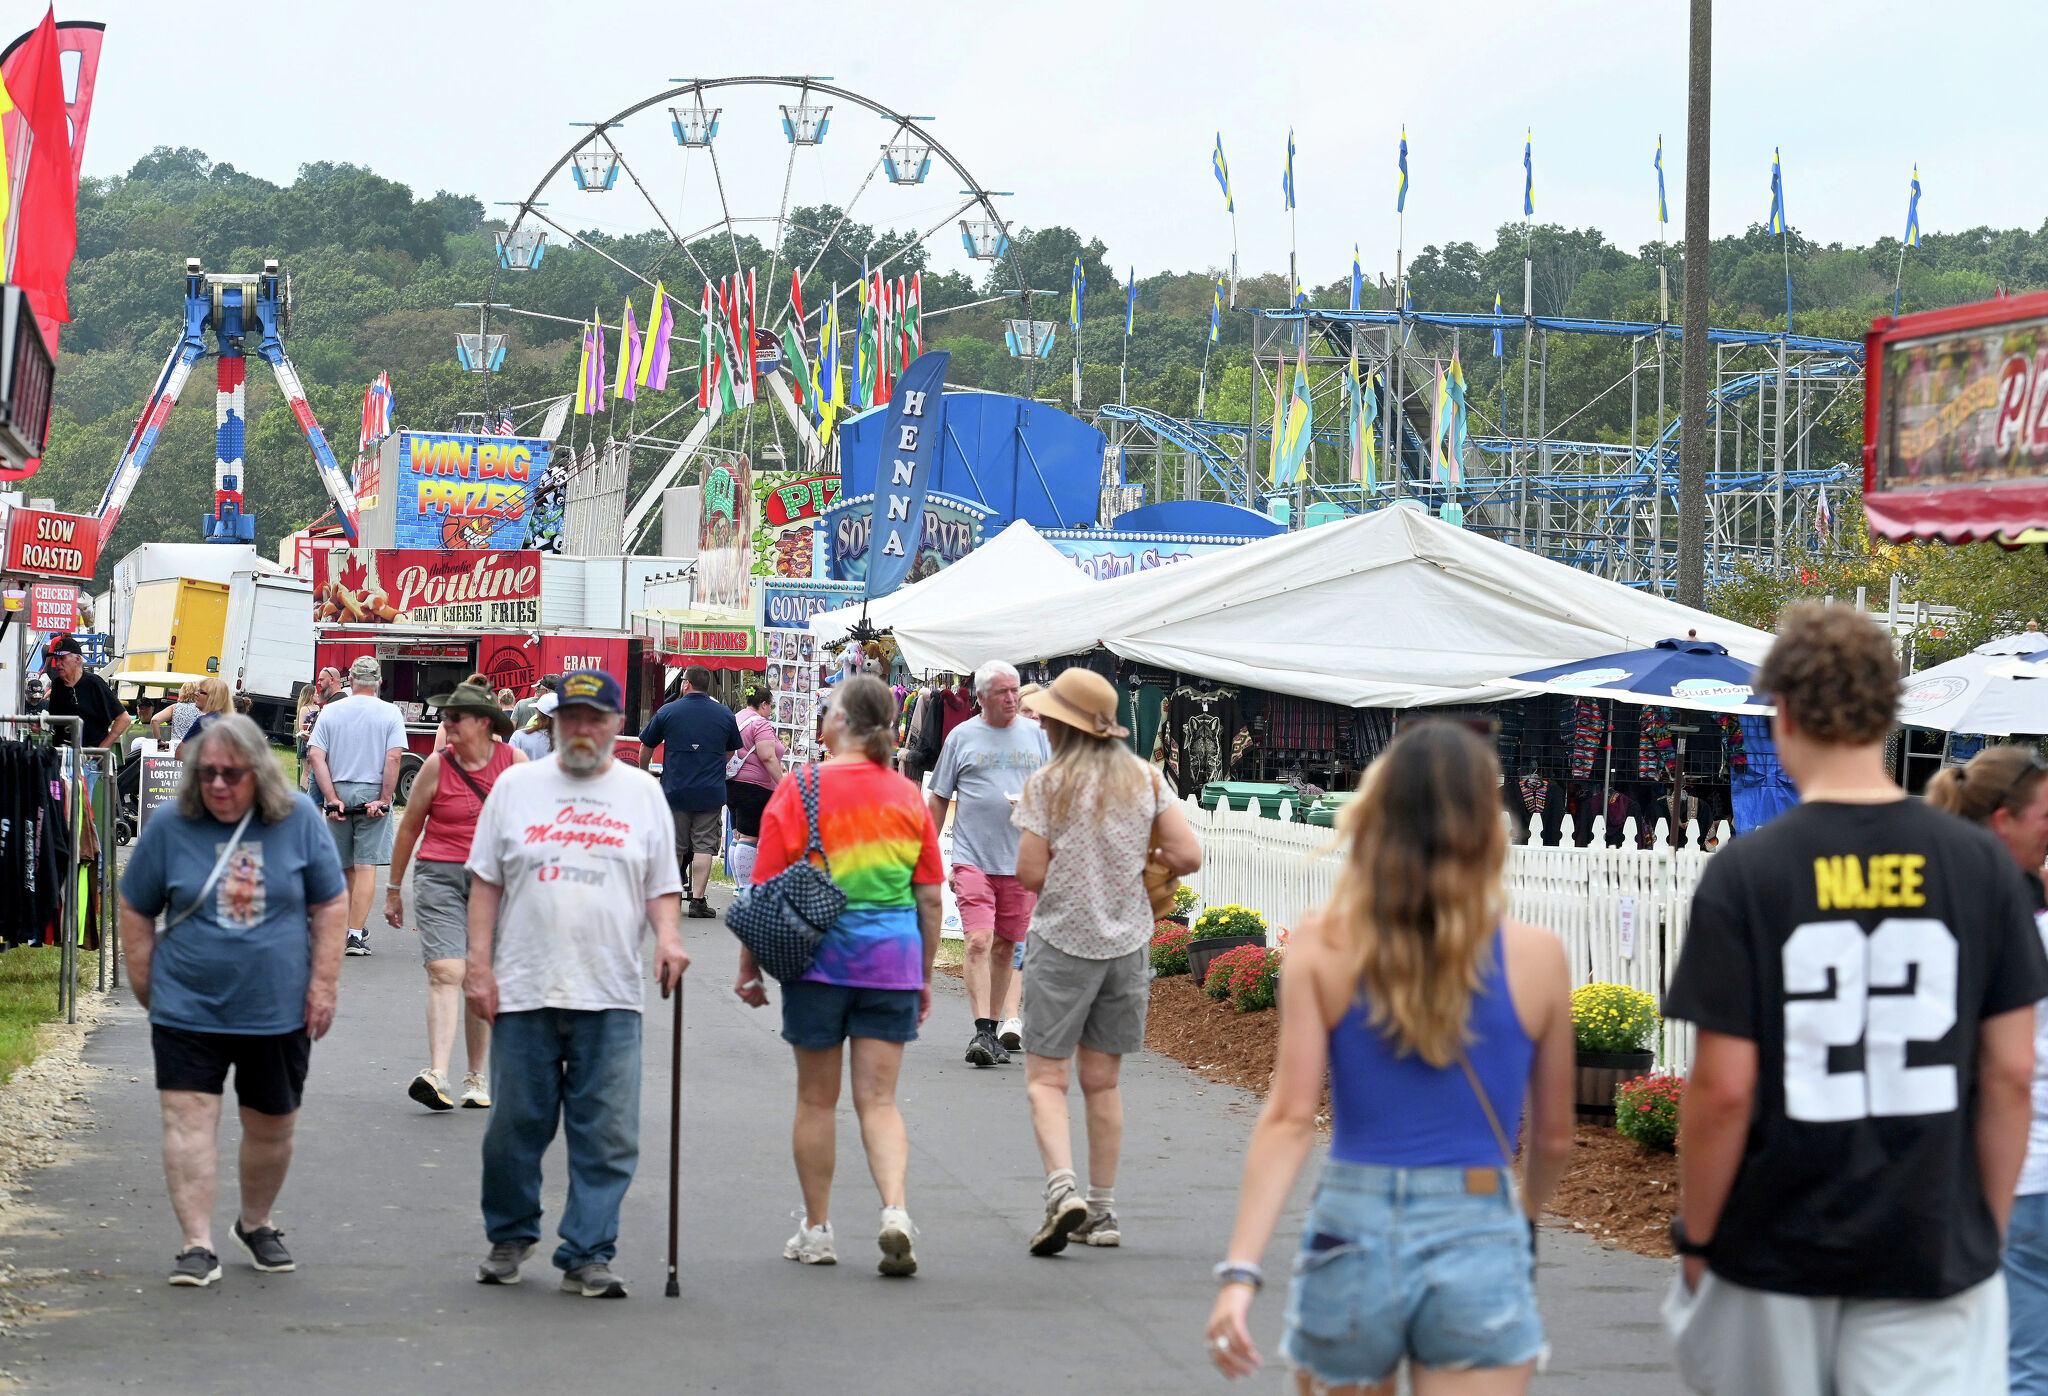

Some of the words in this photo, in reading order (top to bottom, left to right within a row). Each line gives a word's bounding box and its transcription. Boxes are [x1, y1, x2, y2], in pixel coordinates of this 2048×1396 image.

[410, 437, 473, 478] WIN
[477, 442, 531, 482] BIG
[882, 390, 926, 557] HENNA
[417, 480, 527, 520] PRIZES
[37, 517, 75, 542] SLOW
[921, 510, 973, 561] RVE
[22, 543, 83, 572] ROASTED
[429, 560, 471, 576] Authentic
[35, 587, 75, 601] CHICKEN
[396, 554, 536, 612] Poutine
[37, 601, 72, 615] TENDER
[414, 606, 438, 622] GRAVY
[443, 604, 482, 622] CHEESE
[490, 600, 536, 623] FRIES
[770, 595, 827, 622] CONES
[36, 615, 71, 629] BASKET
[702, 631, 747, 650] DRINKS
[563, 655, 602, 672] GRAVY
[490, 668, 535, 688] OUTINE
[1674, 688, 1711, 697] BLUE
[1713, 686, 1750, 696] MOON
[155, 760, 175, 768] MAINE
[556, 805, 630, 833] Outdoor
[524, 823, 625, 850] Magazine
[1814, 854, 1926, 910] NAJEE
[1781, 918, 1959, 1122] 22
